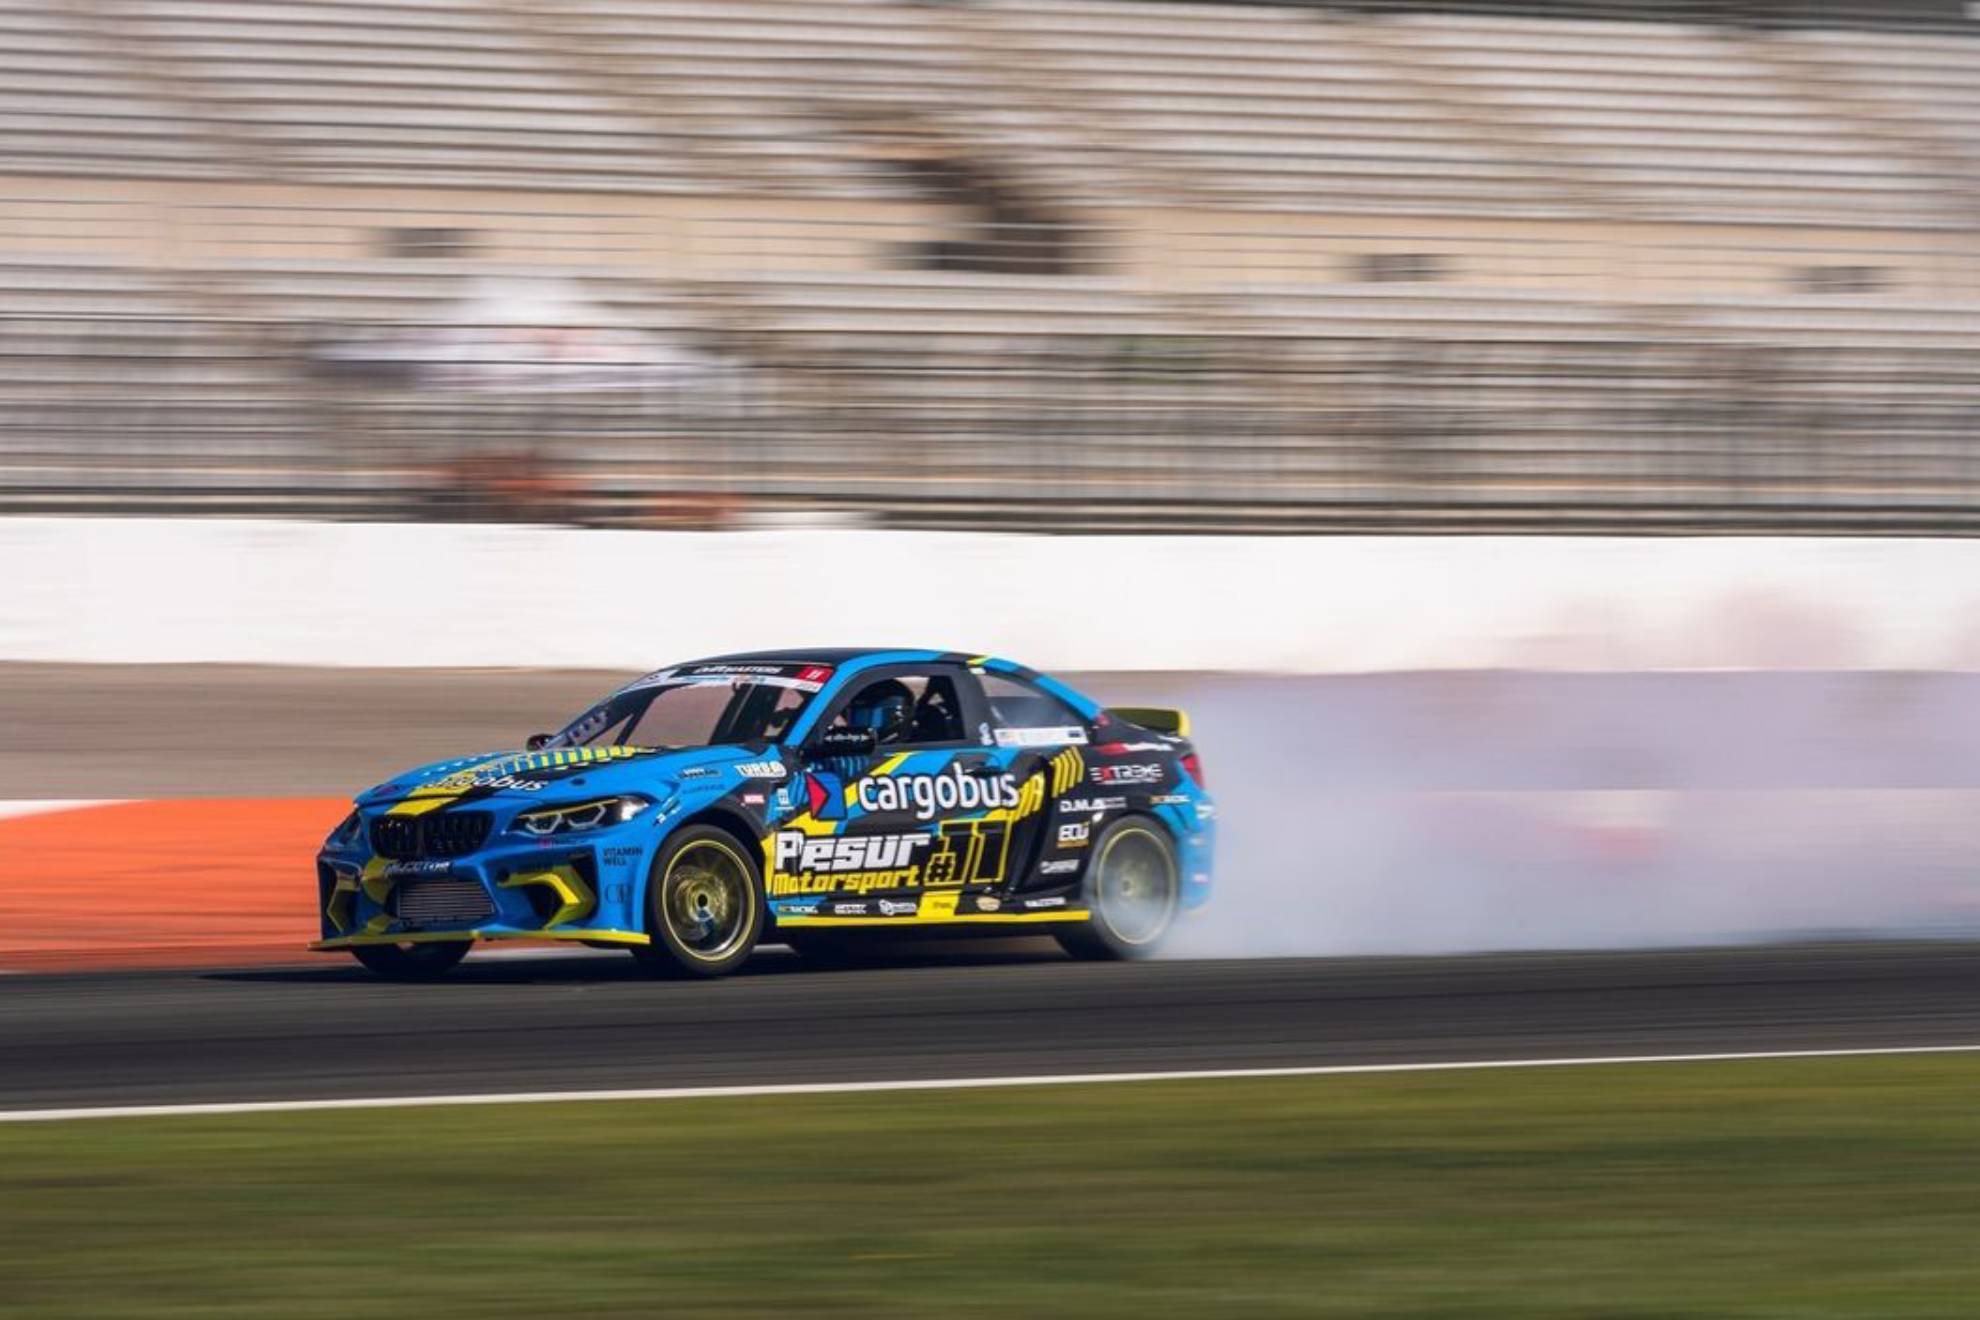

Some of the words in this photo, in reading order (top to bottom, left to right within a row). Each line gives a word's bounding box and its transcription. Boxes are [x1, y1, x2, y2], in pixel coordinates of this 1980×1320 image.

[858, 763, 1019, 819] cargobus
[776, 831, 930, 871] Pesur
[773, 865, 919, 895] Motorsport
